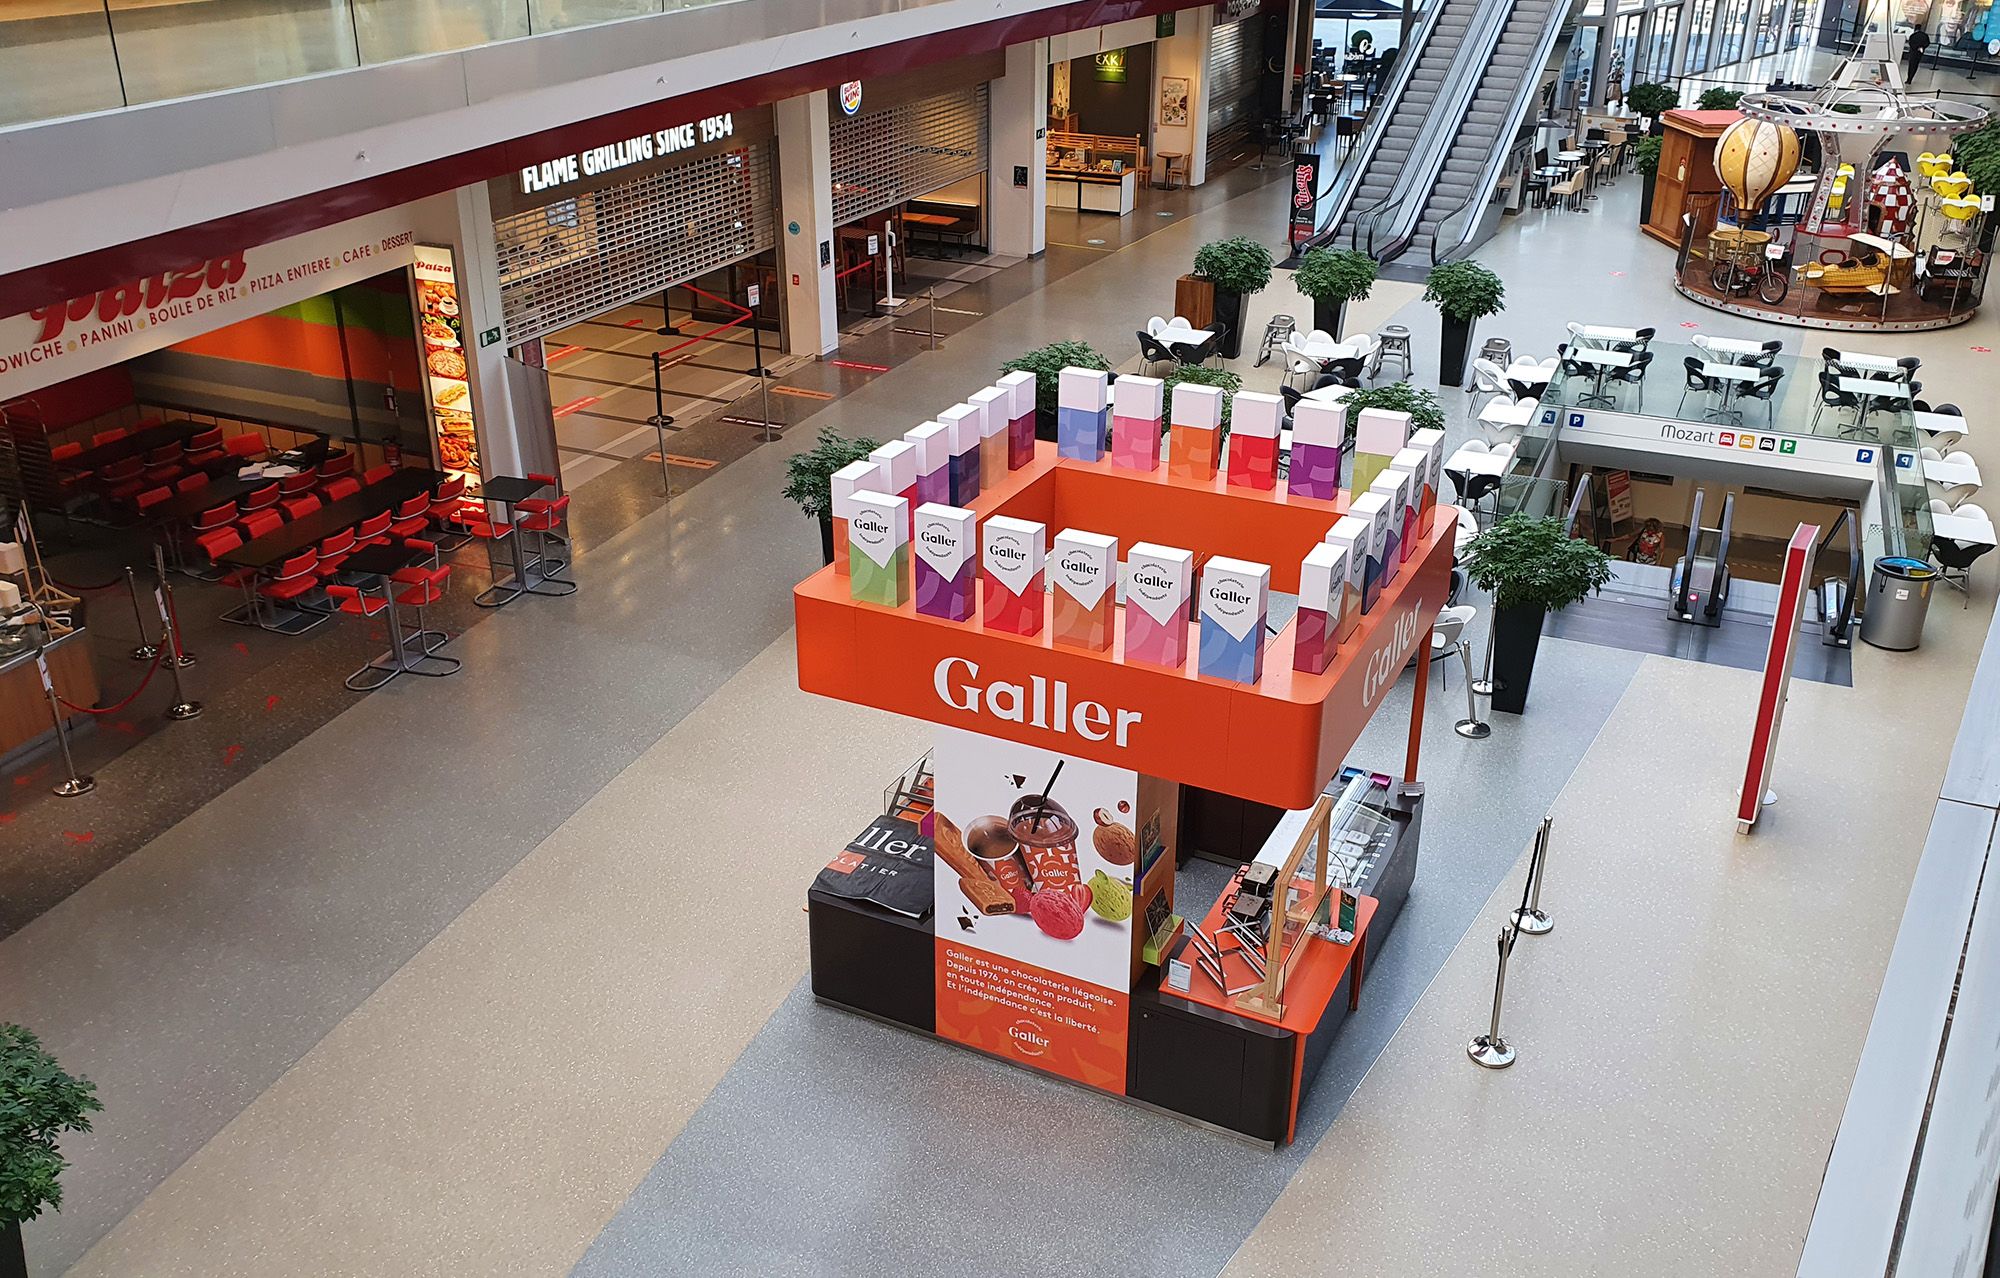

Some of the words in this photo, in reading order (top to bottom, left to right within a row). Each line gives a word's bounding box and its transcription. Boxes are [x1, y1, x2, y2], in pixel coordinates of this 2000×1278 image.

[521, 154, 579, 194] FLAME
[581, 134, 653, 176] GRILLING
[655, 123, 695, 157] SINCE
[699, 113, 733, 143] 1954
[80, 319, 134, 348] PANINI
[149, 300, 193, 326] BOULE
[197, 294, 214, 311] DE
[217, 287, 237, 304] RIZ
[250, 272, 284, 293] PIZZA
[287, 257, 331, 282] ENTIERE
[343, 244, 371, 264] CAFE
[381, 231, 413, 251] DESSERT
[1660, 424, 1714, 444] Mozart
[854, 518, 888, 534] Galler
[921, 531, 957, 547] Galler
[989, 544, 1026, 561] Galler
[1060, 558, 1099, 575] Galler
[1133, 572, 1173, 589] Galler
[1209, 587, 1251, 605] Galler
[1363, 597, 1422, 708] Galler
[933, 656, 1143, 748] Galler
[1000, 869, 1019, 880] Galler
[1041, 868, 1069, 878] Galler
[946, 949, 973, 963] Galler
[975, 959, 990, 968] est
[992, 963, 1009, 974] une
[1011, 969, 1070, 992] chocolaterie
[1072, 986, 1117, 1007] liégeoise.
[946, 959, 977, 975] Depuis
[979, 969, 1001, 983] 1976,
[1004, 978, 1015, 987] on
[1017, 982, 1040, 995] crée,
[1042, 990, 1055, 999] on
[1057, 994, 1096, 1012] produit,
[946, 972, 957, 980] en
[960, 974, 985, 988] toute
[987, 982, 1055, 1010] indépendance.
[946, 980, 957, 990] Et
[1054, 1013, 1063, 1022] la
[1065, 1017, 1100, 1034] liberté.
[1008, 1026, 1050, 1047] Galler
